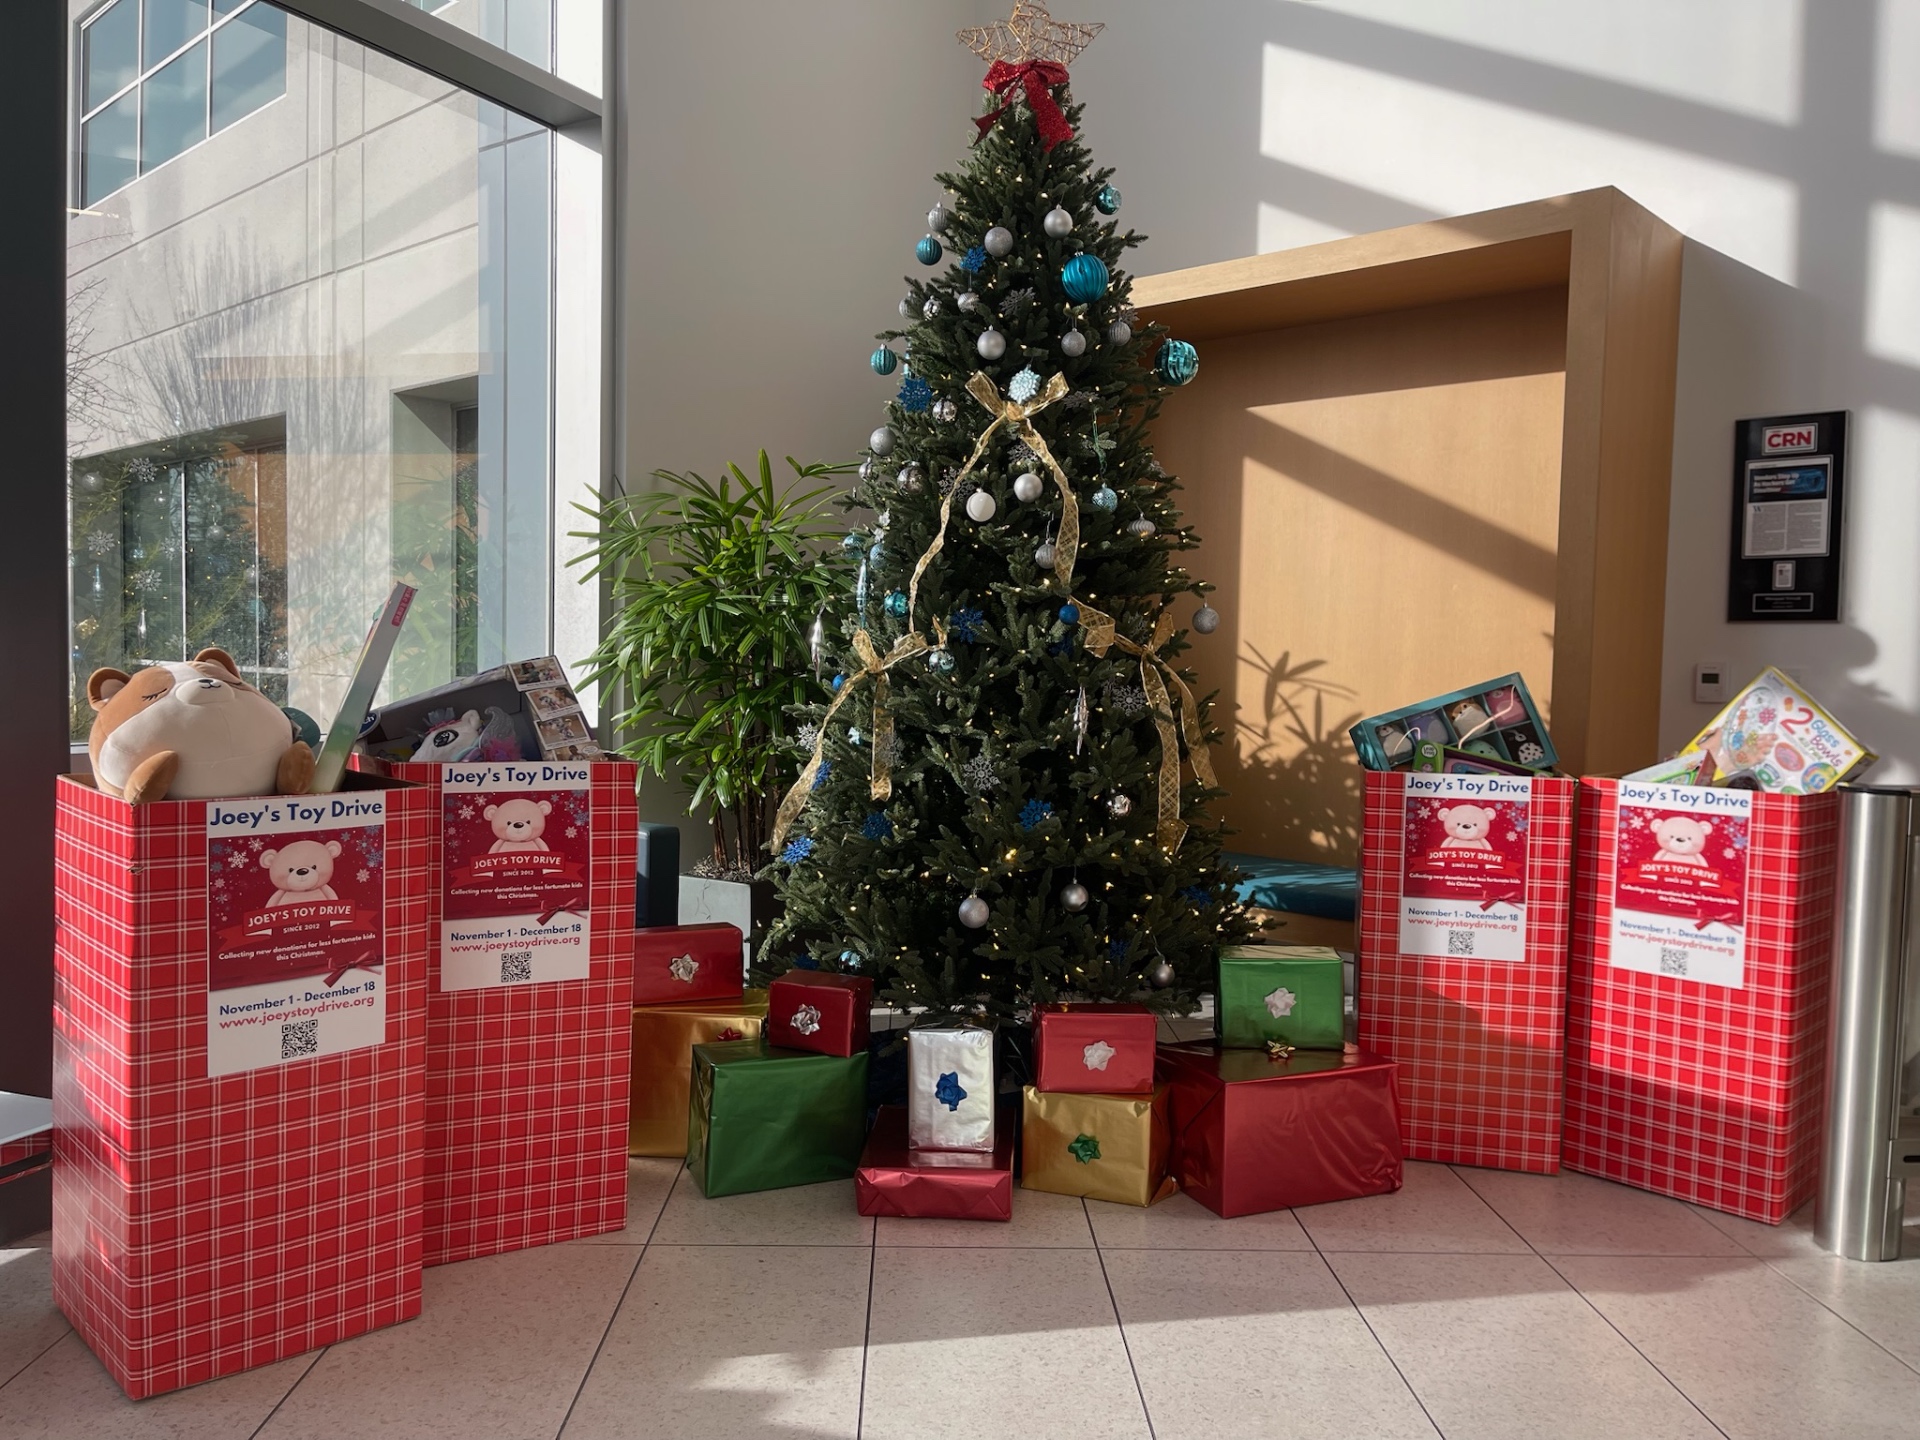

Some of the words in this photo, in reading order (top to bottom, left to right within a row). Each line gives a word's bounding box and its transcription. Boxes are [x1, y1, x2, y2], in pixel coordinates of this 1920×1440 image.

[1767, 431, 1812, 448] CRN
[1780, 707, 1814, 735] 2
[1811, 719, 1840, 748] Glass
[1810, 734, 1843, 767] Bowls
[444, 767, 501, 787] Joey's
[505, 767, 537, 786] Toy
[542, 766, 588, 781] Drive
[1407, 777, 1453, 793] Joey's
[1457, 778, 1485, 795] Toy
[1488, 780, 1529, 793] Drive
[1620, 785, 1666, 802] Joey's
[1670, 789, 1700, 807] Toy
[1704, 792, 1749, 808] Drive
[209, 804, 281, 829] Joey's
[286, 803, 326, 824] Toy
[331, 799, 383, 818] Drive
[474, 856, 508, 869] JOEY'S
[510, 855, 531, 864] TOY
[533, 855, 562, 865] DRIVE
[1428, 851, 1457, 859] JOEY'S
[1459, 851, 1476, 859] TOY
[1477, 852, 1503, 863] DRIVE
[1641, 864, 1670, 873] JOEY'S
[1672, 866, 1690, 874] TOY
[1691, 868, 1719, 881] DRIVE
[248, 910, 289, 927] JOEY'S
[292, 906, 316, 918] TOY
[319, 905, 352, 915] DRIVE
[1408, 907, 1454, 917] November
[1465, 911, 1508, 921] December
[283, 925, 302, 934] SINCE
[304, 923, 320, 931] 2012
[450, 929, 504, 942] November
[506, 929, 511, 937] 1
[520, 924, 569, 937] December
[570, 923, 582, 933] 18
[1408, 918, 1518, 933] www.joeystoydrive.org
[1620, 920, 1664, 933] November
[1666, 927, 1671, 935] 1
[1678, 929, 1724, 943] December
[1726, 936, 1736, 945] 18
[218, 950, 255, 960] Collecting
[272, 943, 307, 953] donations
[307, 941, 318, 949] for
[318, 939, 331, 947] less
[331, 935, 362, 945] fortunate
[362, 933, 376, 941] kids
[450, 936, 581, 953] www.joeystoydrive.org
[1619, 931, 1735, 956] www.joeystoydrive.org
[276, 953, 289, 961] this
[289, 950, 326, 959] Christmas.
[219, 998, 286, 1016] November
[288, 995, 294, 1005] 1
[304, 984, 361, 1002] December
[363, 980, 376, 992] 18
[219, 996, 375, 1030] www.joeystoydrive.org
